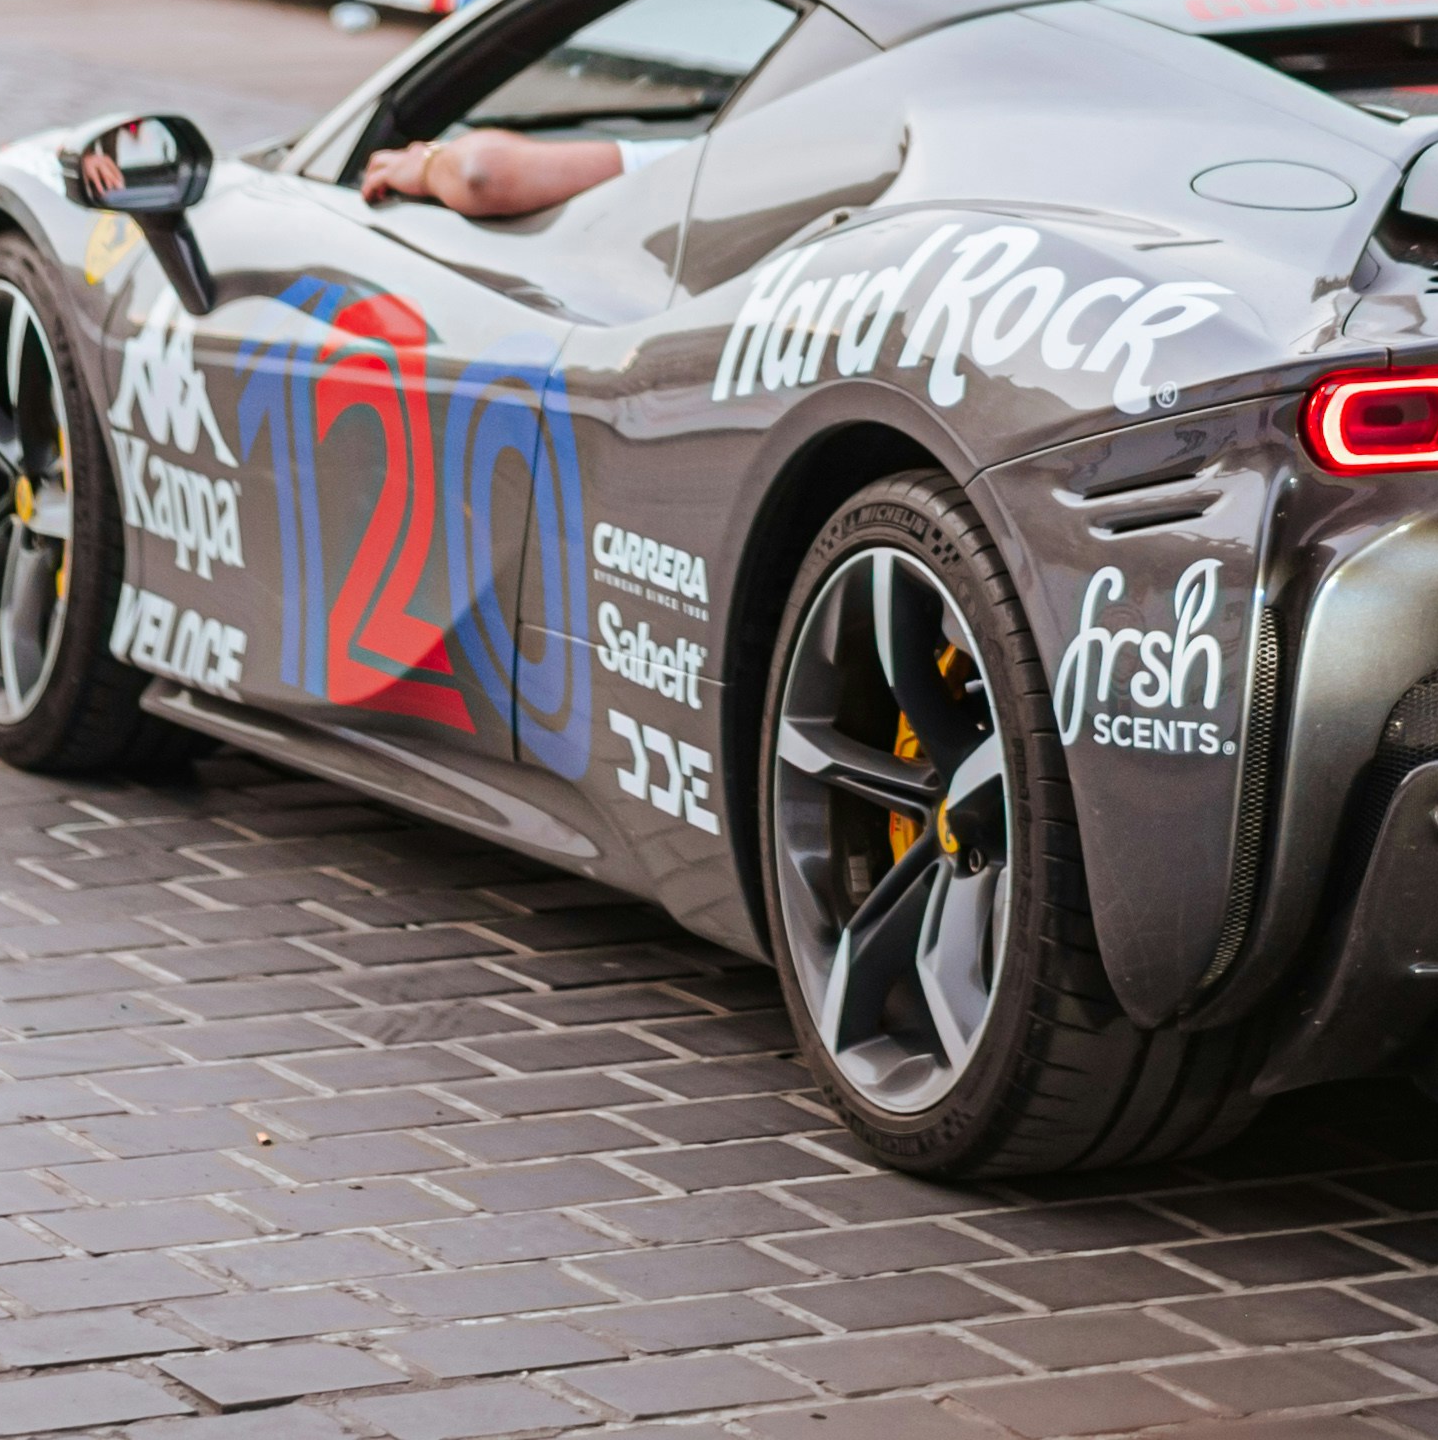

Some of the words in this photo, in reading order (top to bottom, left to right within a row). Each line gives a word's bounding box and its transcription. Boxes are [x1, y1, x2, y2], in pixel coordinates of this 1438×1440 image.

[711, 223, 963, 403] Hard
[897, 224, 1236, 415] Rock
[110, 428, 246, 582] Kappa
[235, 274, 592, 782] 120
[592, 521, 709, 604] CARRERA
[859, 504, 930, 542] MICHELIN
[109, 582, 248, 703] VELOCE
[598, 601, 704, 710] Sabelt
[1053, 558, 1224, 746] frsh
[1093, 713, 1220, 754] SCENTS
